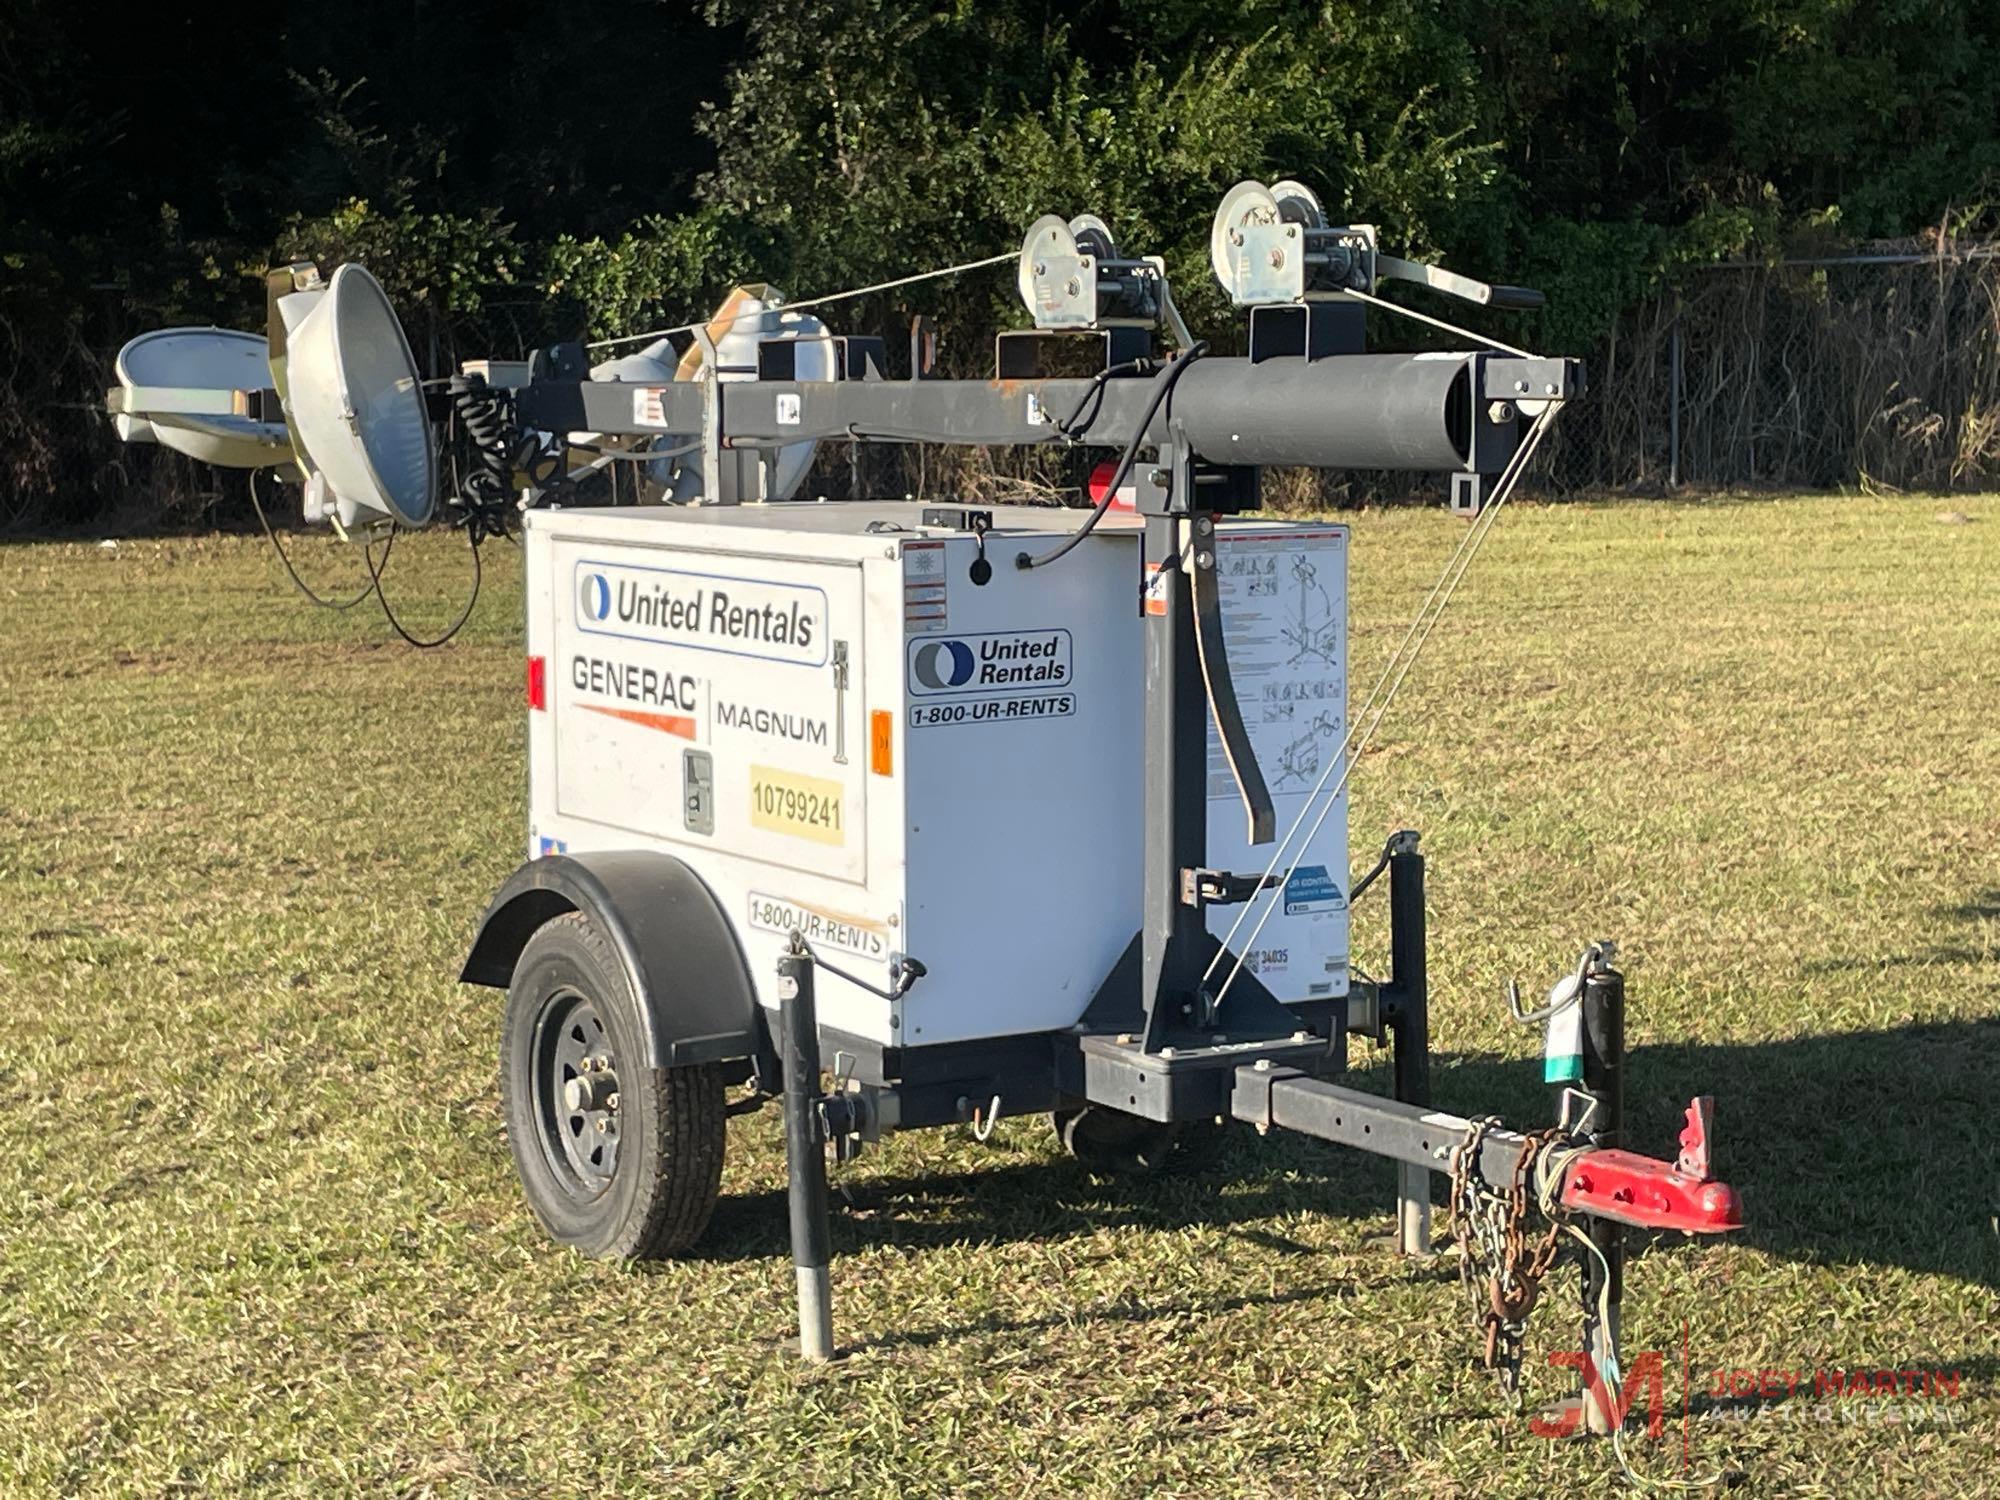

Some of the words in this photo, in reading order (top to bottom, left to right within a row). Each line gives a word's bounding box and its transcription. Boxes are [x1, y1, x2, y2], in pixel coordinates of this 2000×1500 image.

[618, 580, 702, 631] United
[710, 591, 813, 647] Rentals
[979, 659, 1066, 685] Rentals
[980, 636, 1059, 661] United
[572, 656, 697, 712] GENERAC
[717, 701, 828, 747] MAGNUM
[914, 697, 1071, 725] 1-800-UR-RENTS
[753, 780, 840, 831] 10799241
[752, 899, 882, 954] 1-800-UR-RENTS
